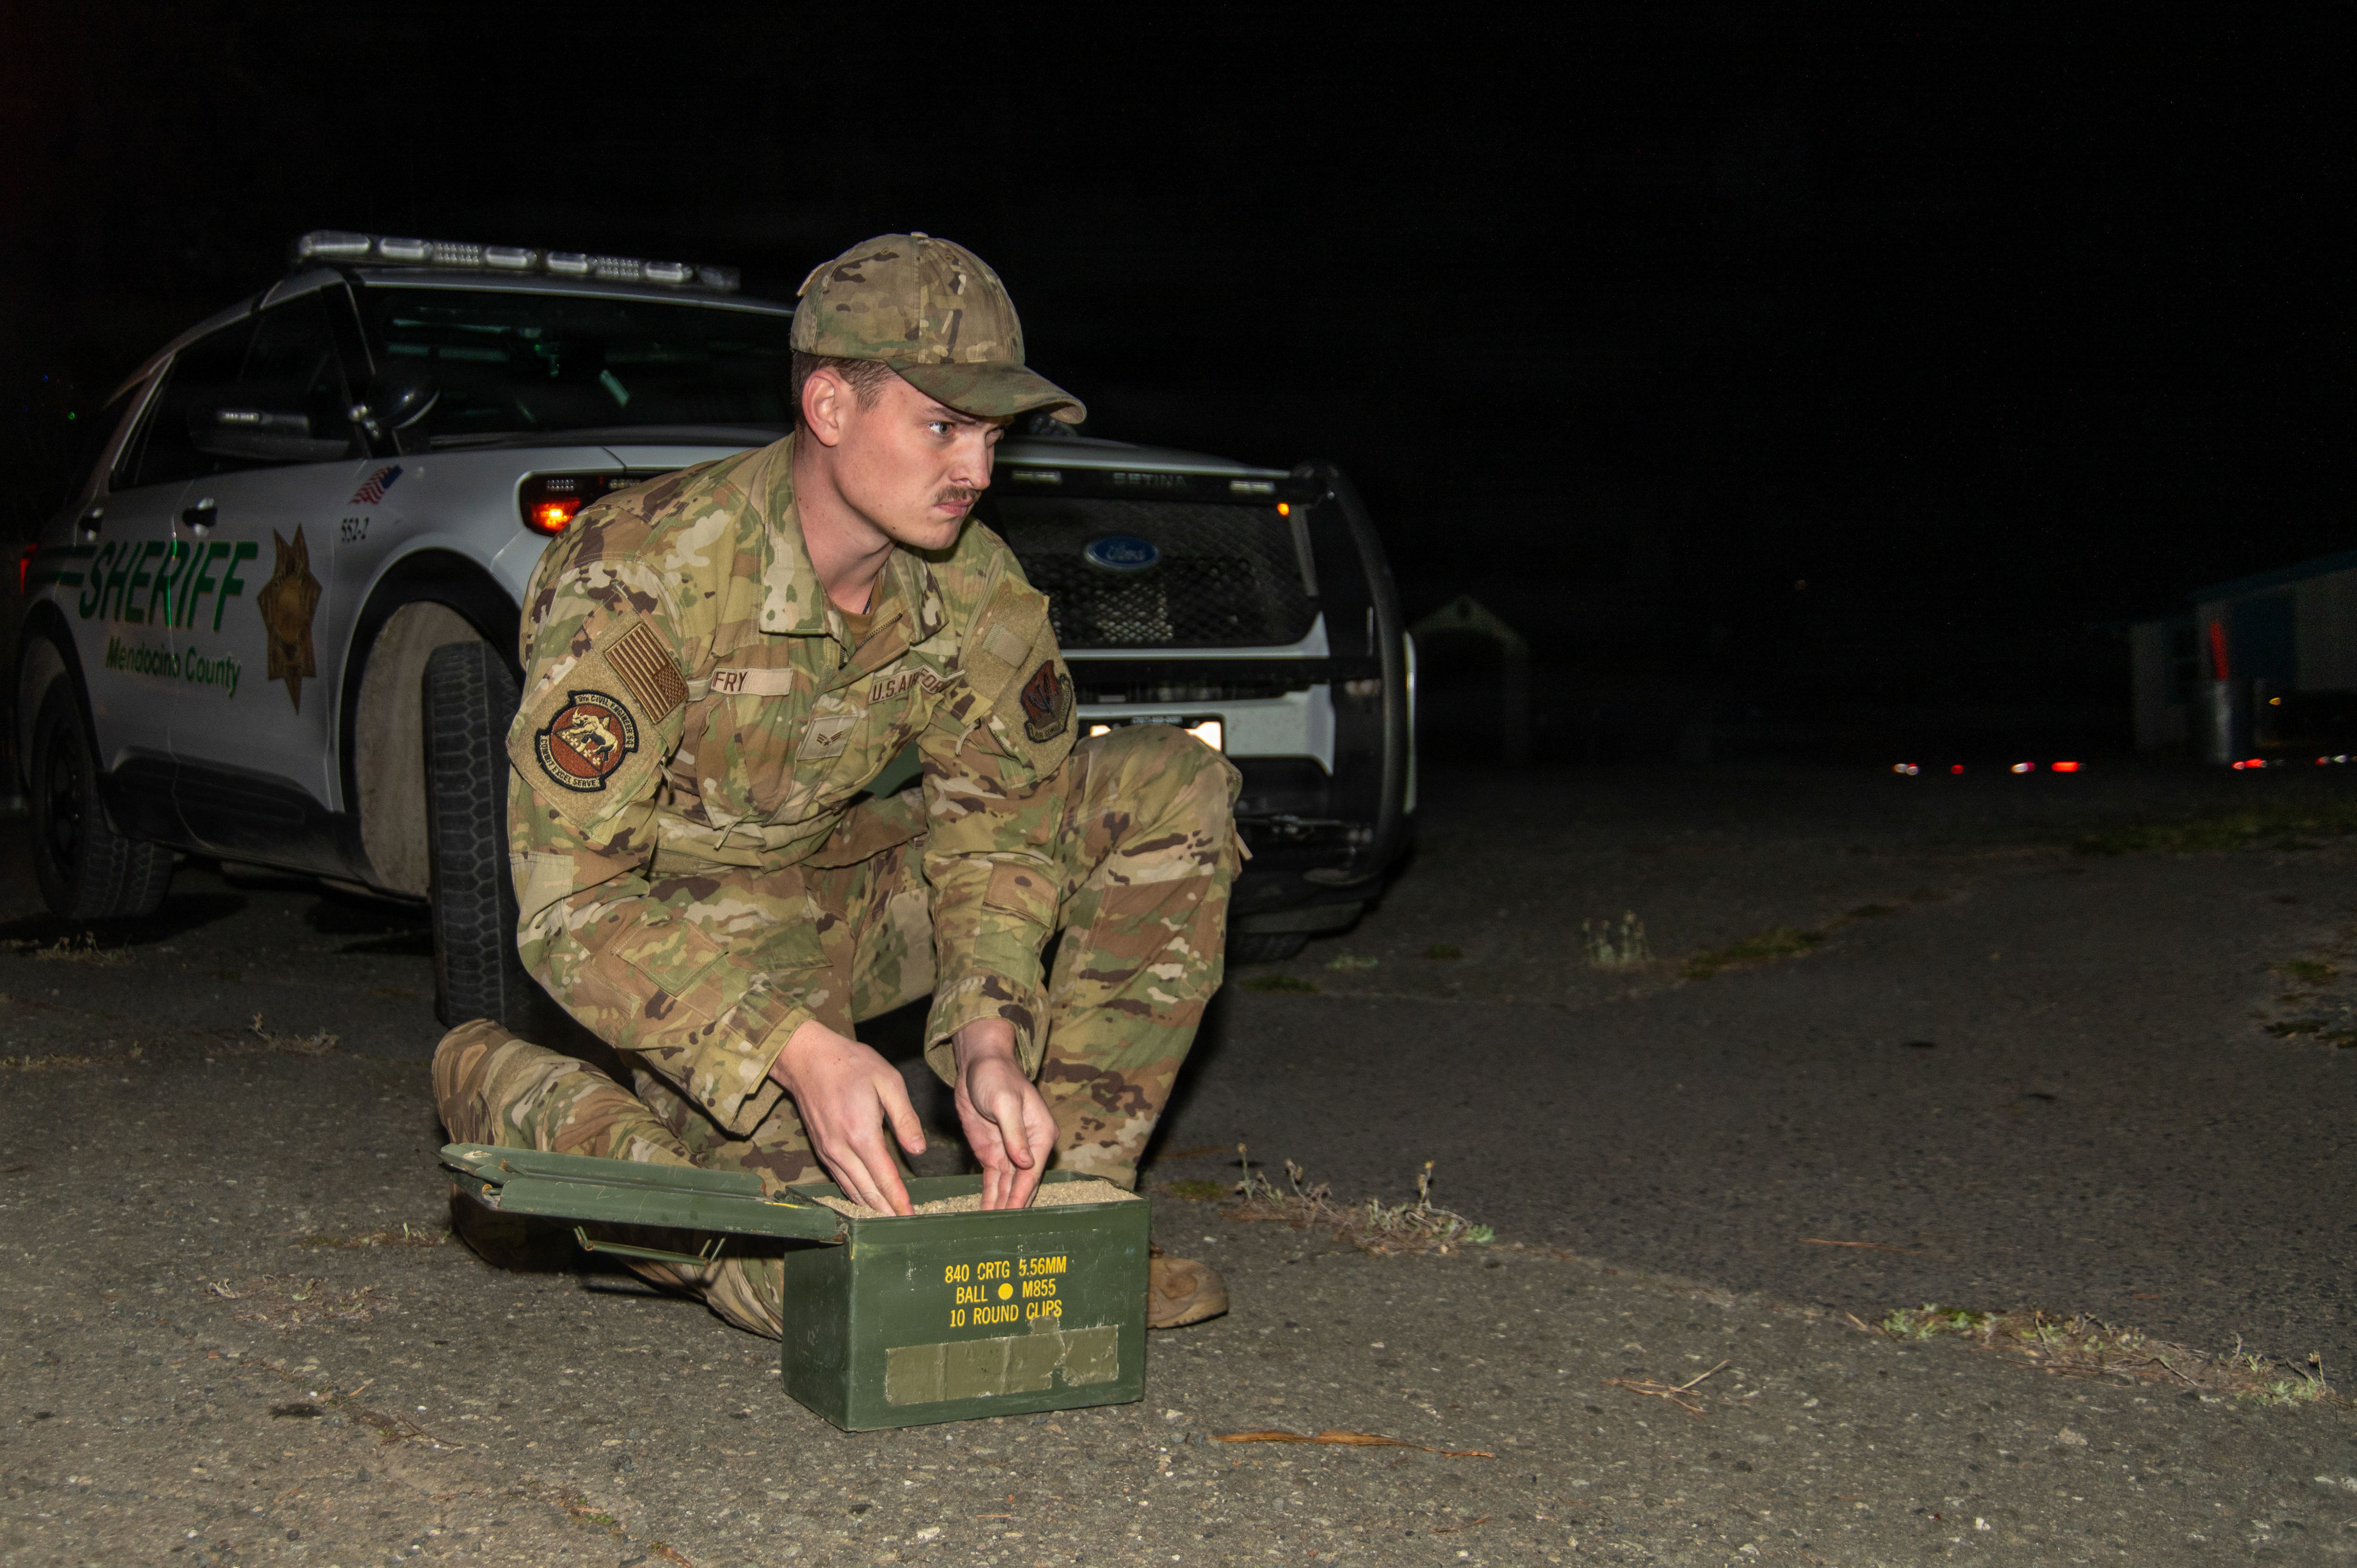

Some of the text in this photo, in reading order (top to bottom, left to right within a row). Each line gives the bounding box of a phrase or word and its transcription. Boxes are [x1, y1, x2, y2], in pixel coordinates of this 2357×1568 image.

[79, 540, 258, 632] SHERIFF
[106, 636, 242, 698] Mendocino County
[713, 671, 748, 692] FRY
[898, 671, 920, 693] AIR
[591, 695, 611, 707] CIVIL
[610, 703, 633, 732] ENGINEER
[541, 738, 555, 767] COMMIT
[552, 766, 571, 784] EXCEL
[945, 1256, 1067, 1284] 840 CRTG 5.56MM
[956, 1278, 1056, 1304] BALL M855
[950, 1299, 1062, 1327] 10 ROUND CLIPS
